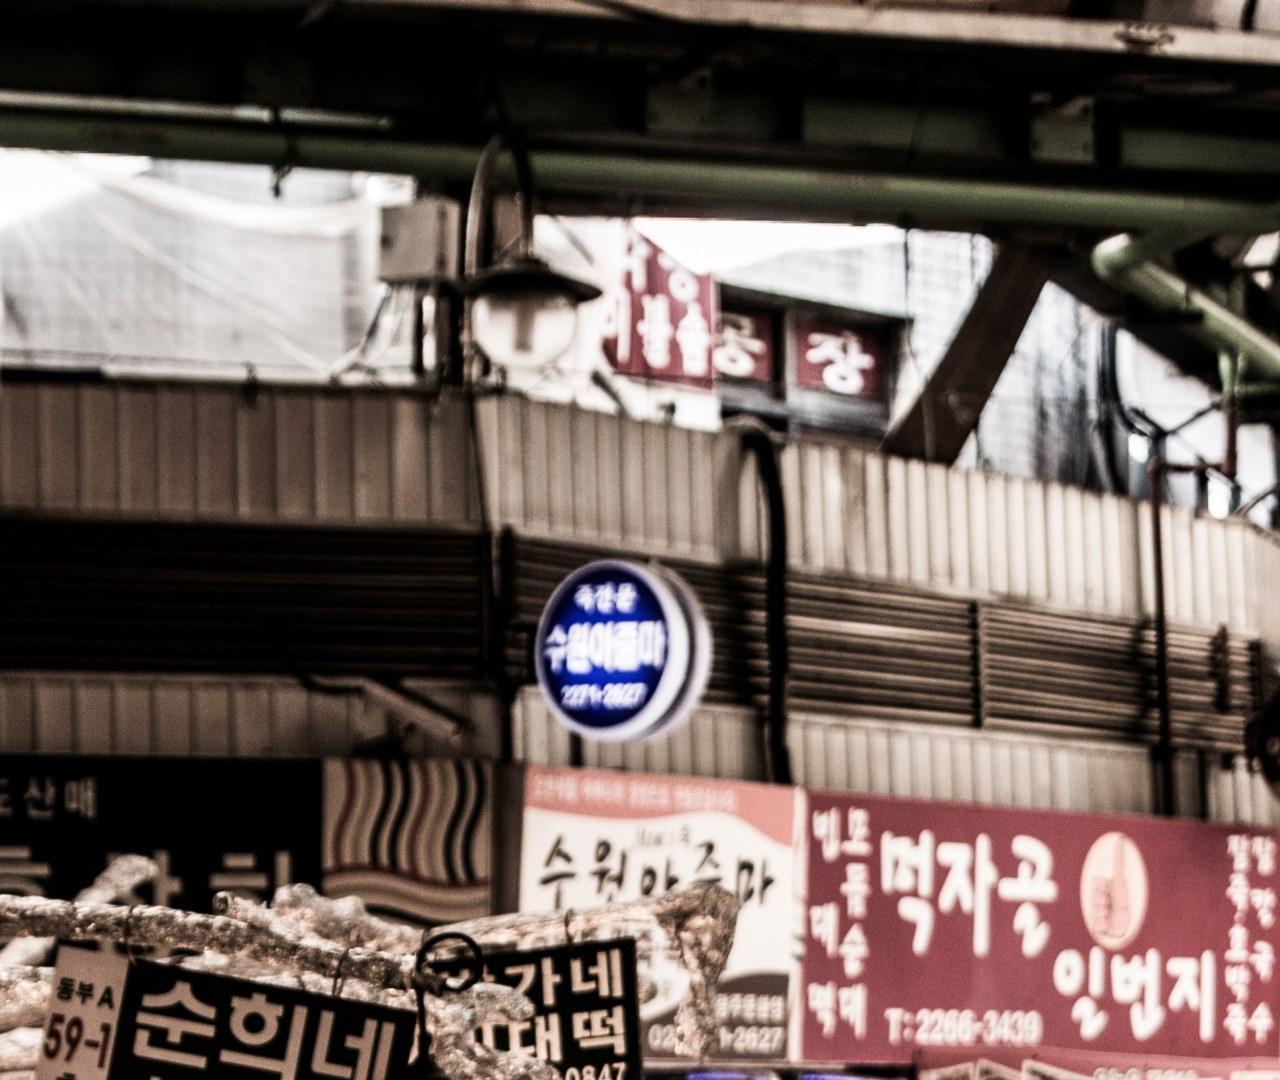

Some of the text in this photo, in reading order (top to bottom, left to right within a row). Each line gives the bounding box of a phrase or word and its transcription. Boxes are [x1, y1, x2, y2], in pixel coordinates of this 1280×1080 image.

[879, 829, 1060, 959] 먹자골
[56, 977, 115, 1011] 동부 A
[1052, 946, 1217, 1044] 일번지
[42, 1011, 113, 1070] 59-1
